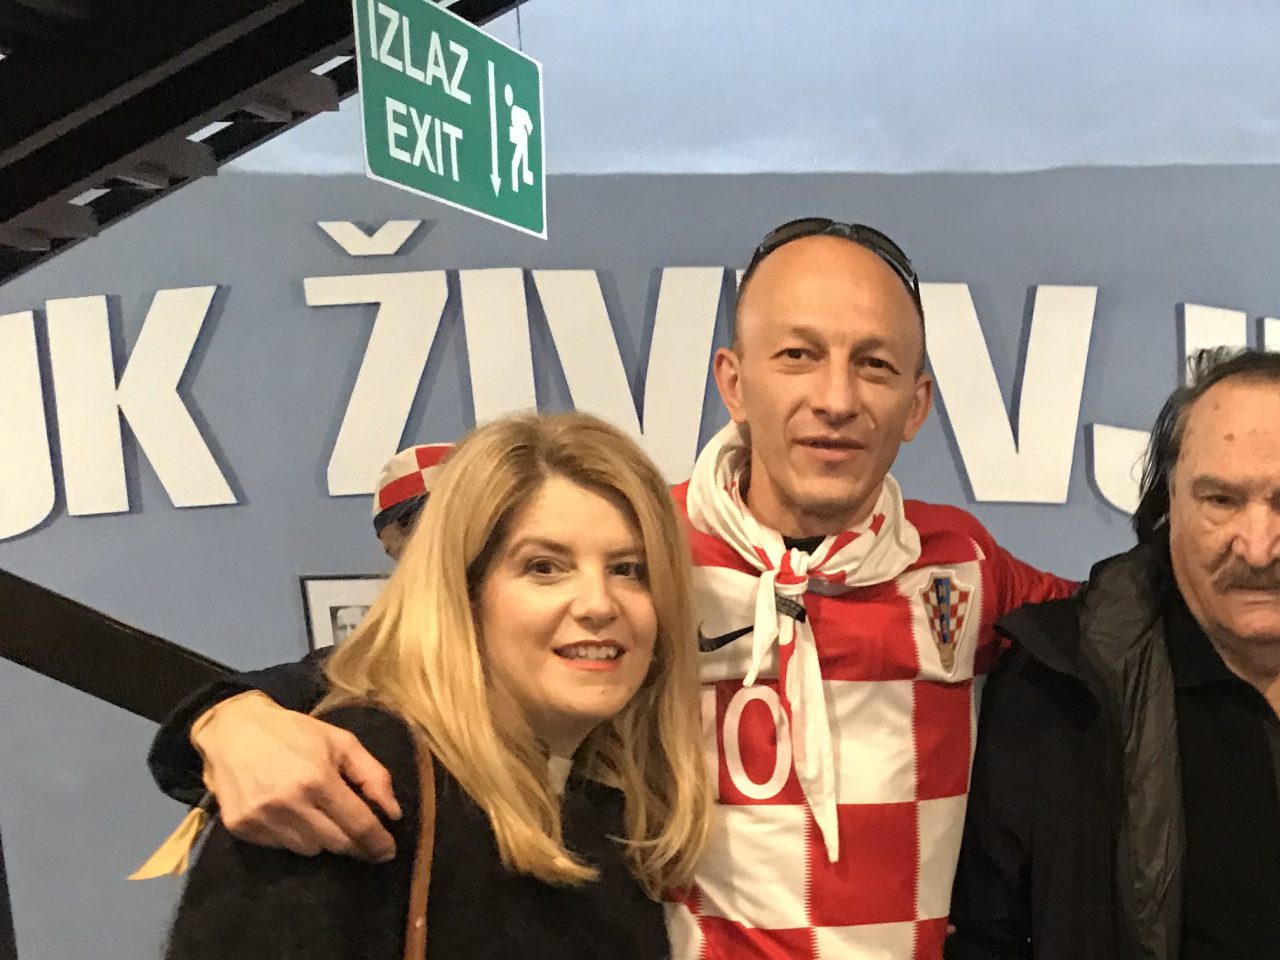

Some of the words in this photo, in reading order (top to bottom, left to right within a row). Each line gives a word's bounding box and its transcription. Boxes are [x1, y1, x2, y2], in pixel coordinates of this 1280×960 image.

[367, 0, 472, 105] IZLAZ
[385, 96, 463, 182] EXIT
[303, 220, 746, 496] ŽIV
